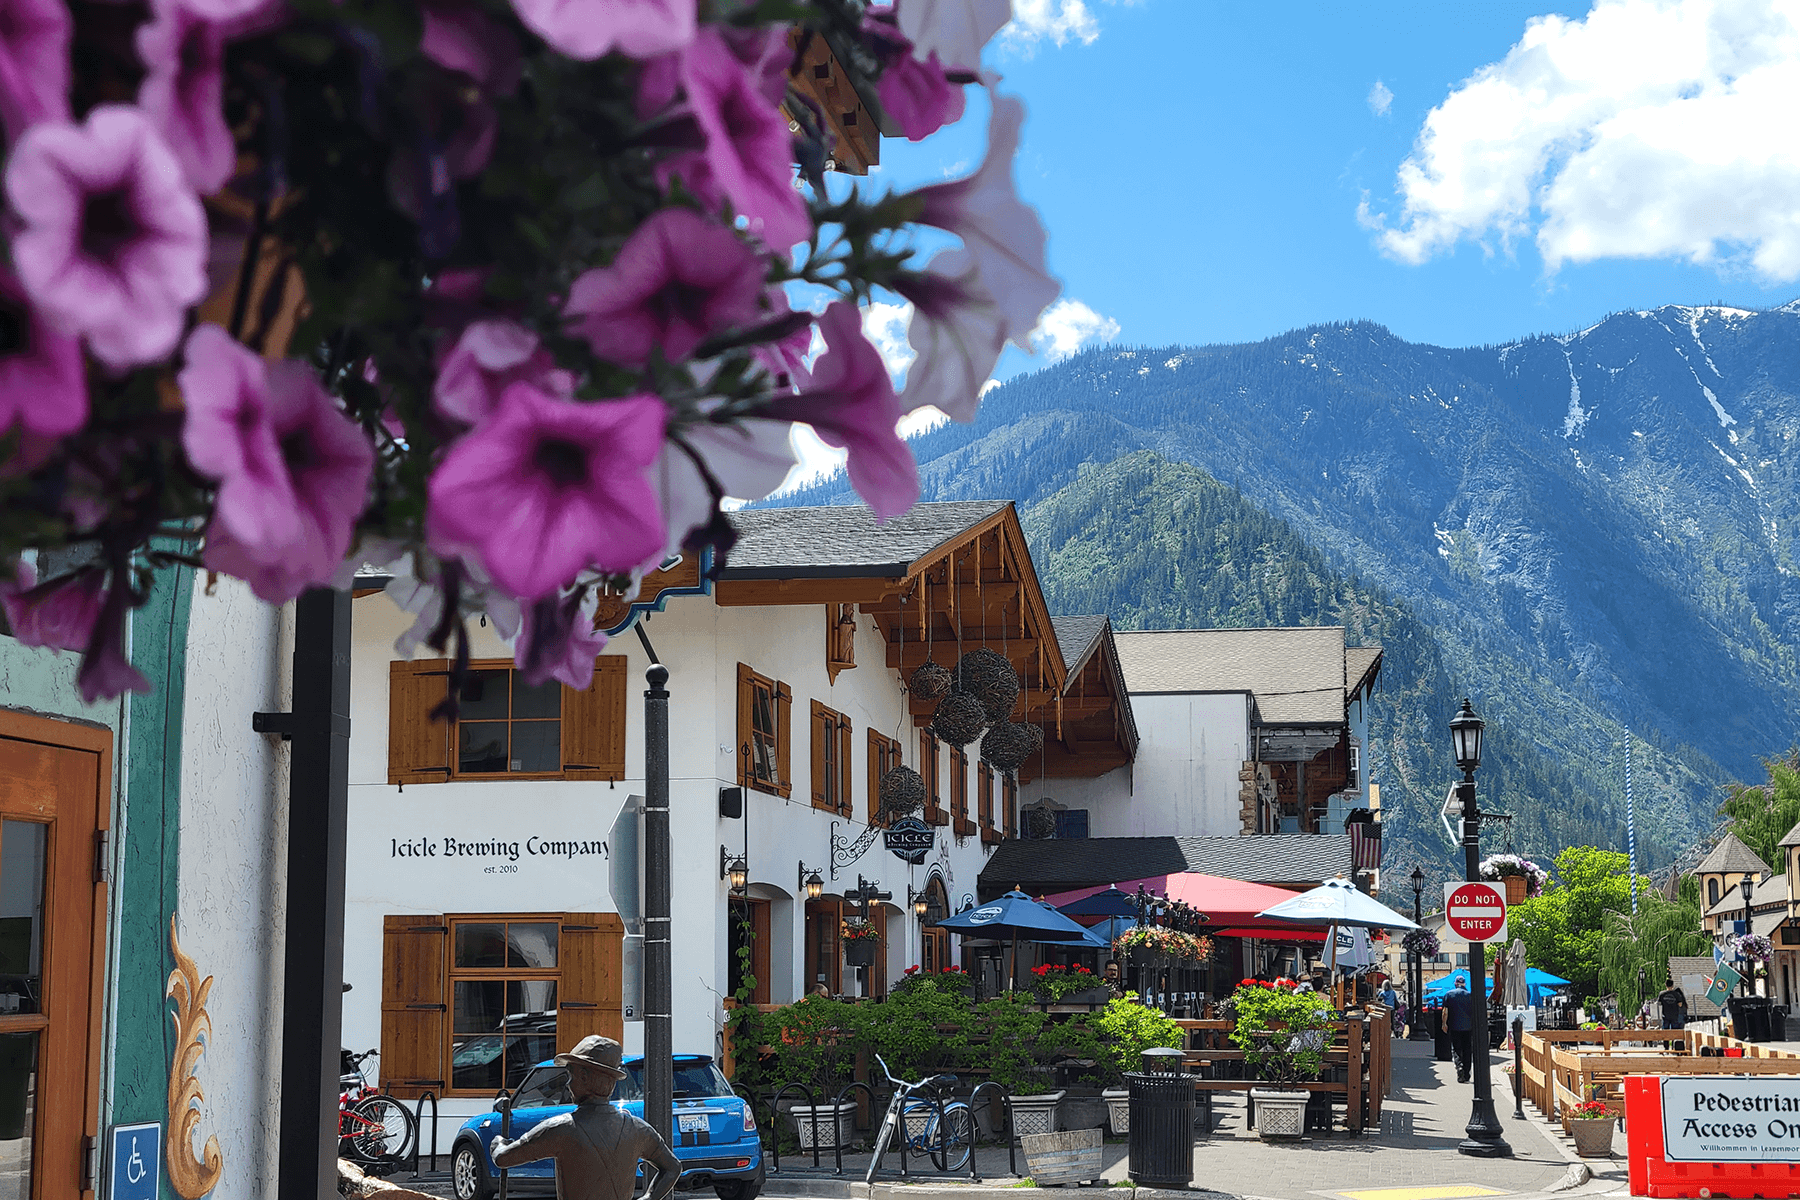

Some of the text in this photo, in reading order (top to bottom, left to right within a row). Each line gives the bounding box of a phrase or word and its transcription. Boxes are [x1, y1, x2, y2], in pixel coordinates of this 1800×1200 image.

[886, 833, 932, 843] ICICLE
[391, 836, 609, 862] Icicle Brewing Company
[484, 865, 518, 874] est. 2010
[1454, 895, 1496, 905] DO NOT
[1460, 920, 1492, 929] ENTER
[1682, 1118, 1757, 1138] Access
[1700, 1144, 1748, 1152] Willkommen
[1750, 1144, 1758, 1152] in
